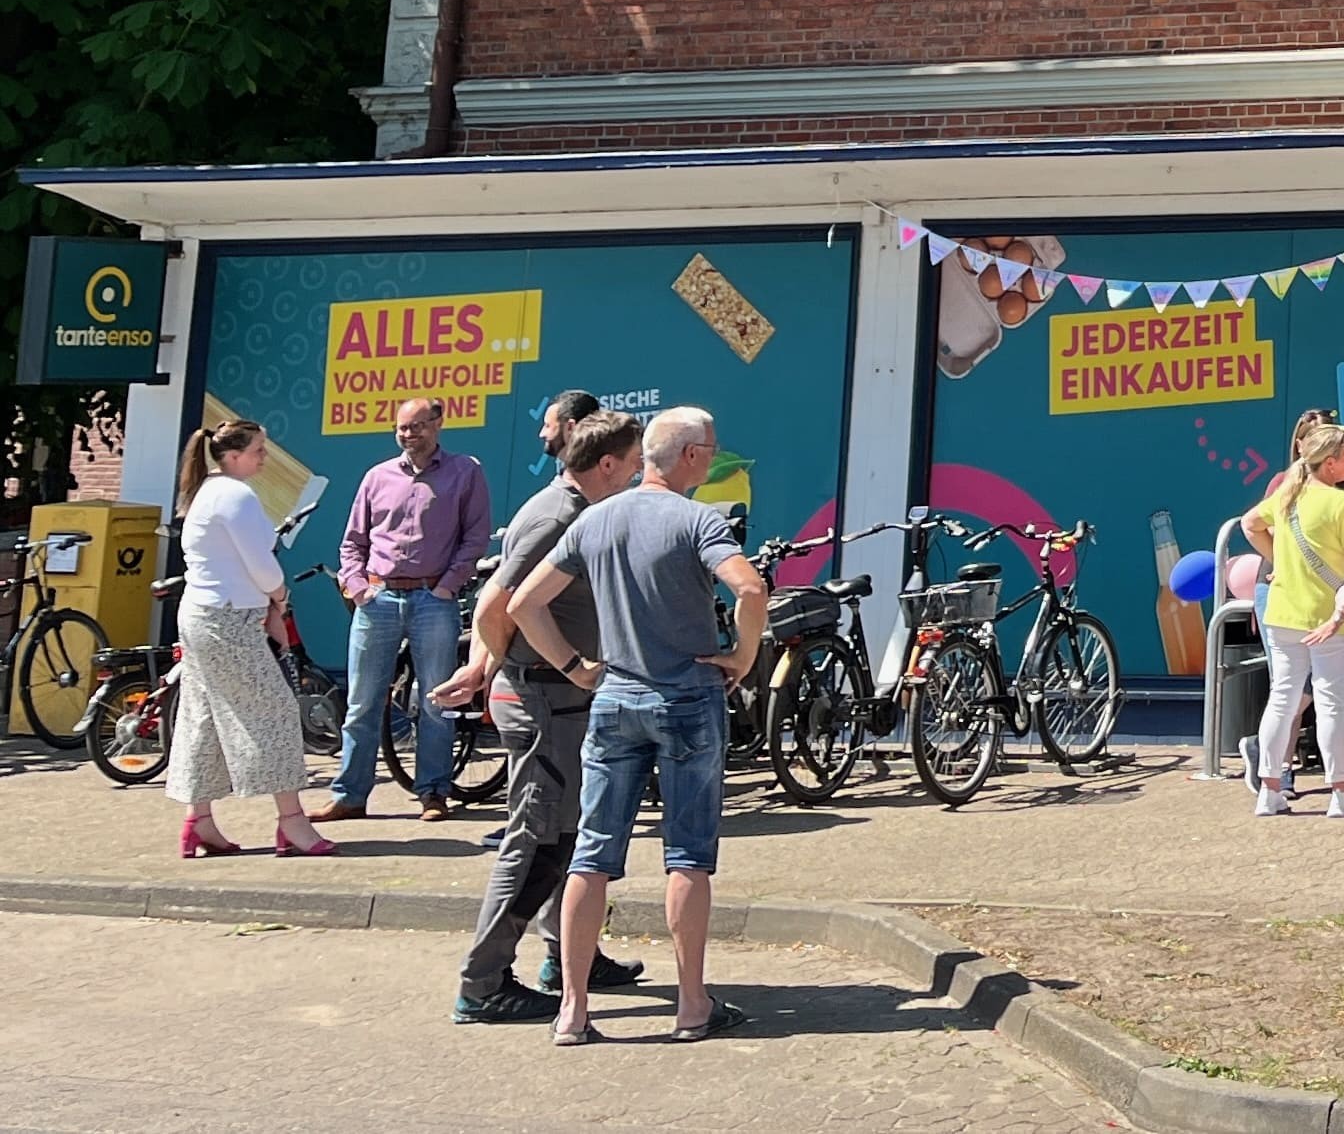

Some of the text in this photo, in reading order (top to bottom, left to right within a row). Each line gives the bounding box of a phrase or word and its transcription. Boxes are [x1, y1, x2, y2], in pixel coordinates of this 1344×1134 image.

[55, 325, 153, 346] tanteenso
[1061, 312, 1244, 357] JEDERZEIT
[334, 363, 504, 394] VON ALUFOLIE
[1062, 354, 1263, 400] EINKAUFEN
[331, 402, 367, 425] BIS
